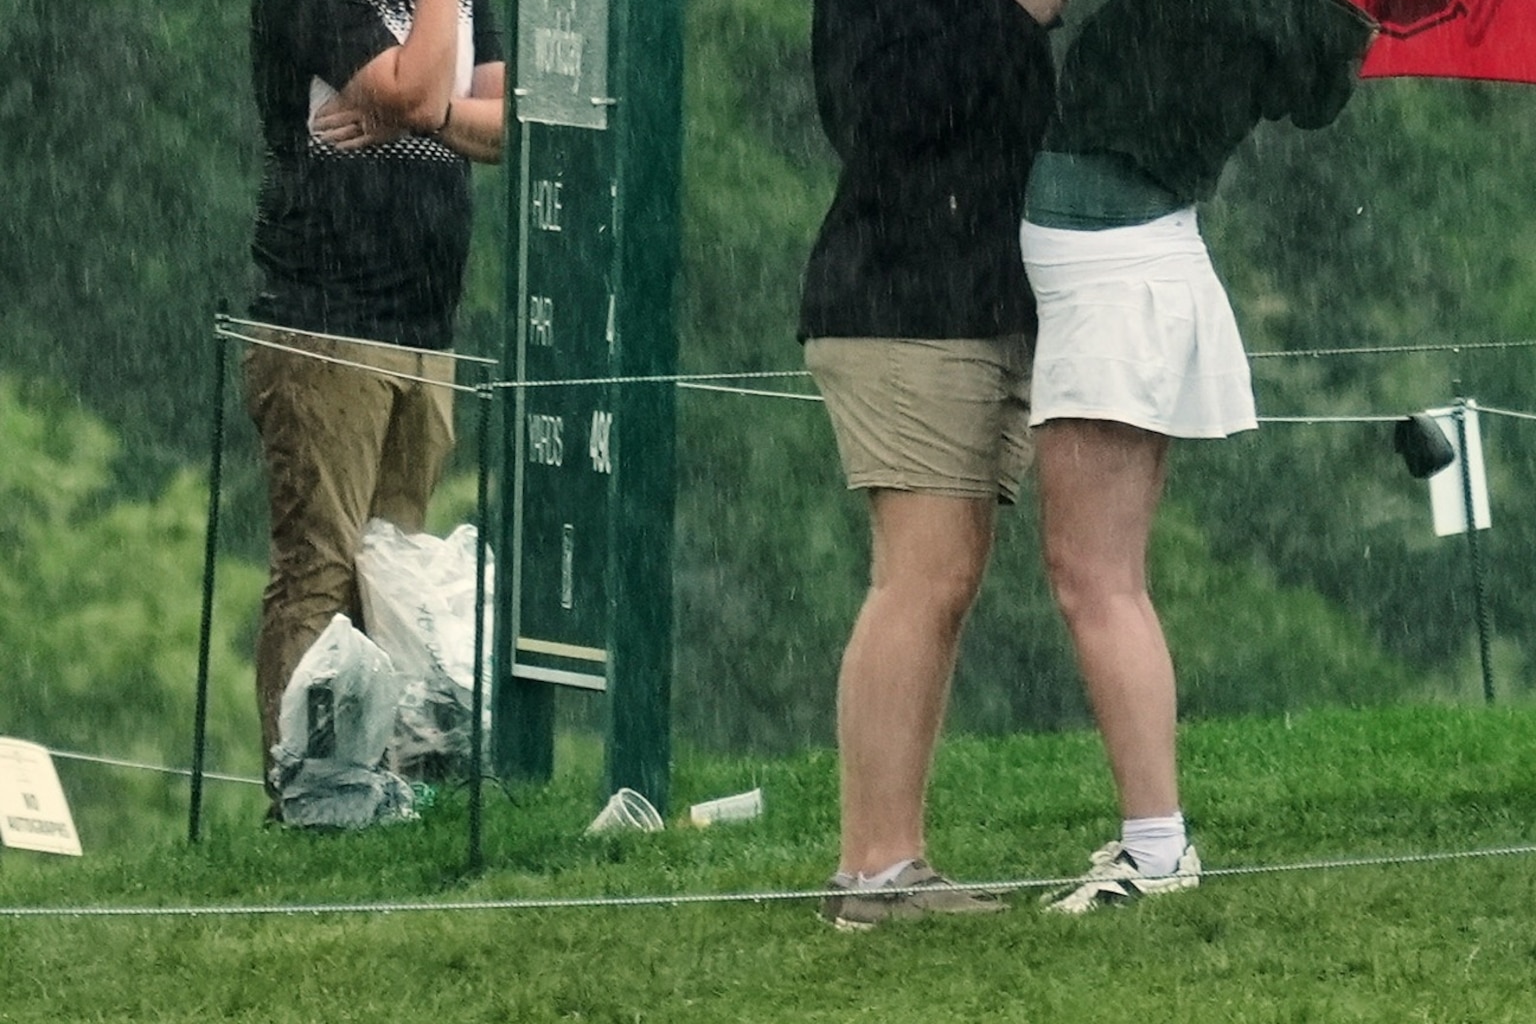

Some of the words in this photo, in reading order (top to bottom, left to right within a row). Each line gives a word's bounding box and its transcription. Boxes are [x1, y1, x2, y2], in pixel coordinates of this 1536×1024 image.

[533, 180, 562, 231] HOLE
[529, 296, 553, 347] PAR
[528, 414, 563, 467] YARDS
